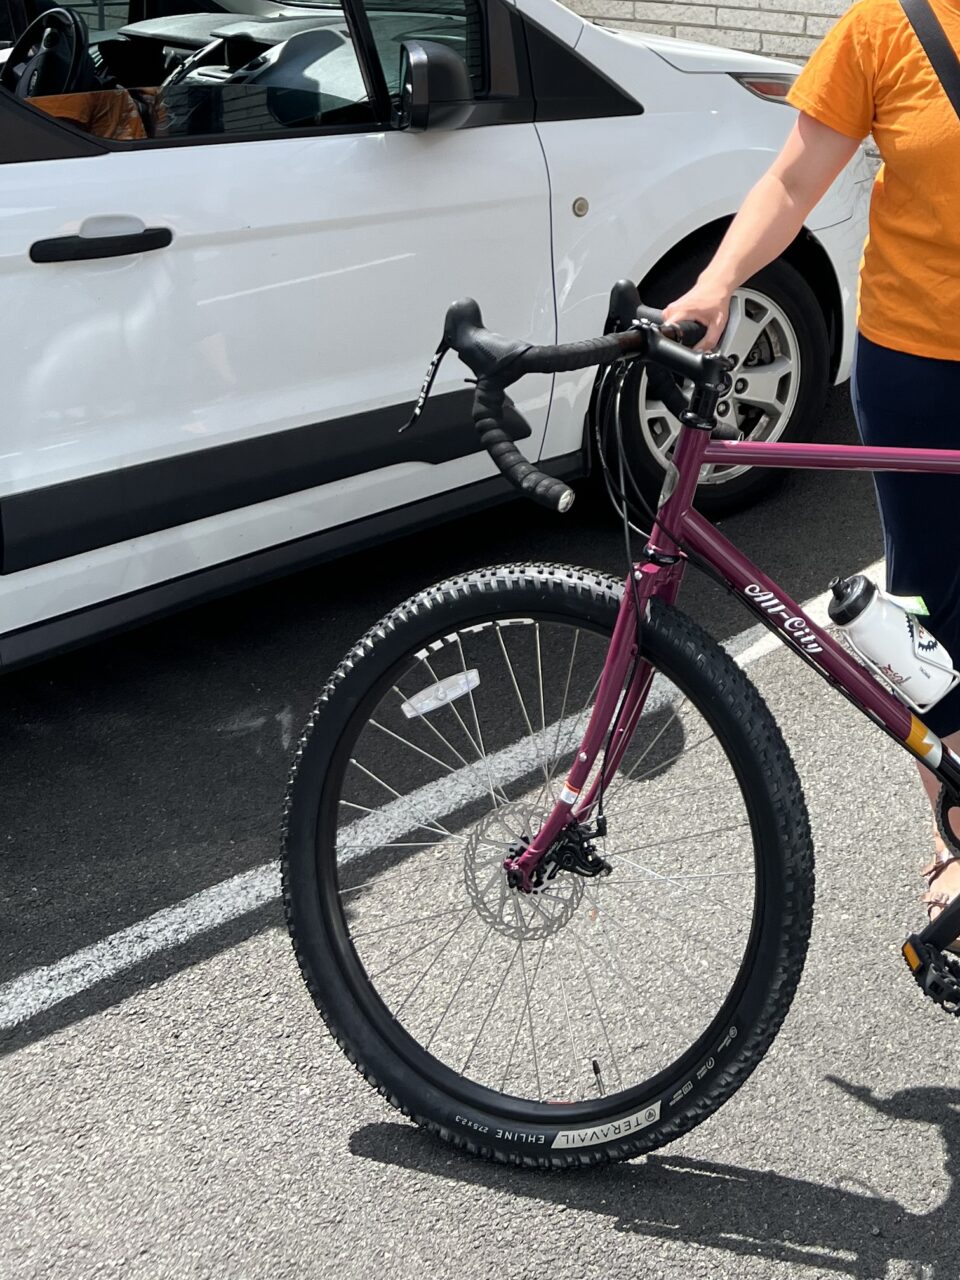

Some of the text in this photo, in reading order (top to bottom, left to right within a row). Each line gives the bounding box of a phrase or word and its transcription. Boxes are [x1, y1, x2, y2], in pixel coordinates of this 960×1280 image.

[744, 584, 823, 653] All-City
[495, 1129, 545, 1144] EHLINE
[561, 1116, 643, 1145] TERAVAIL
